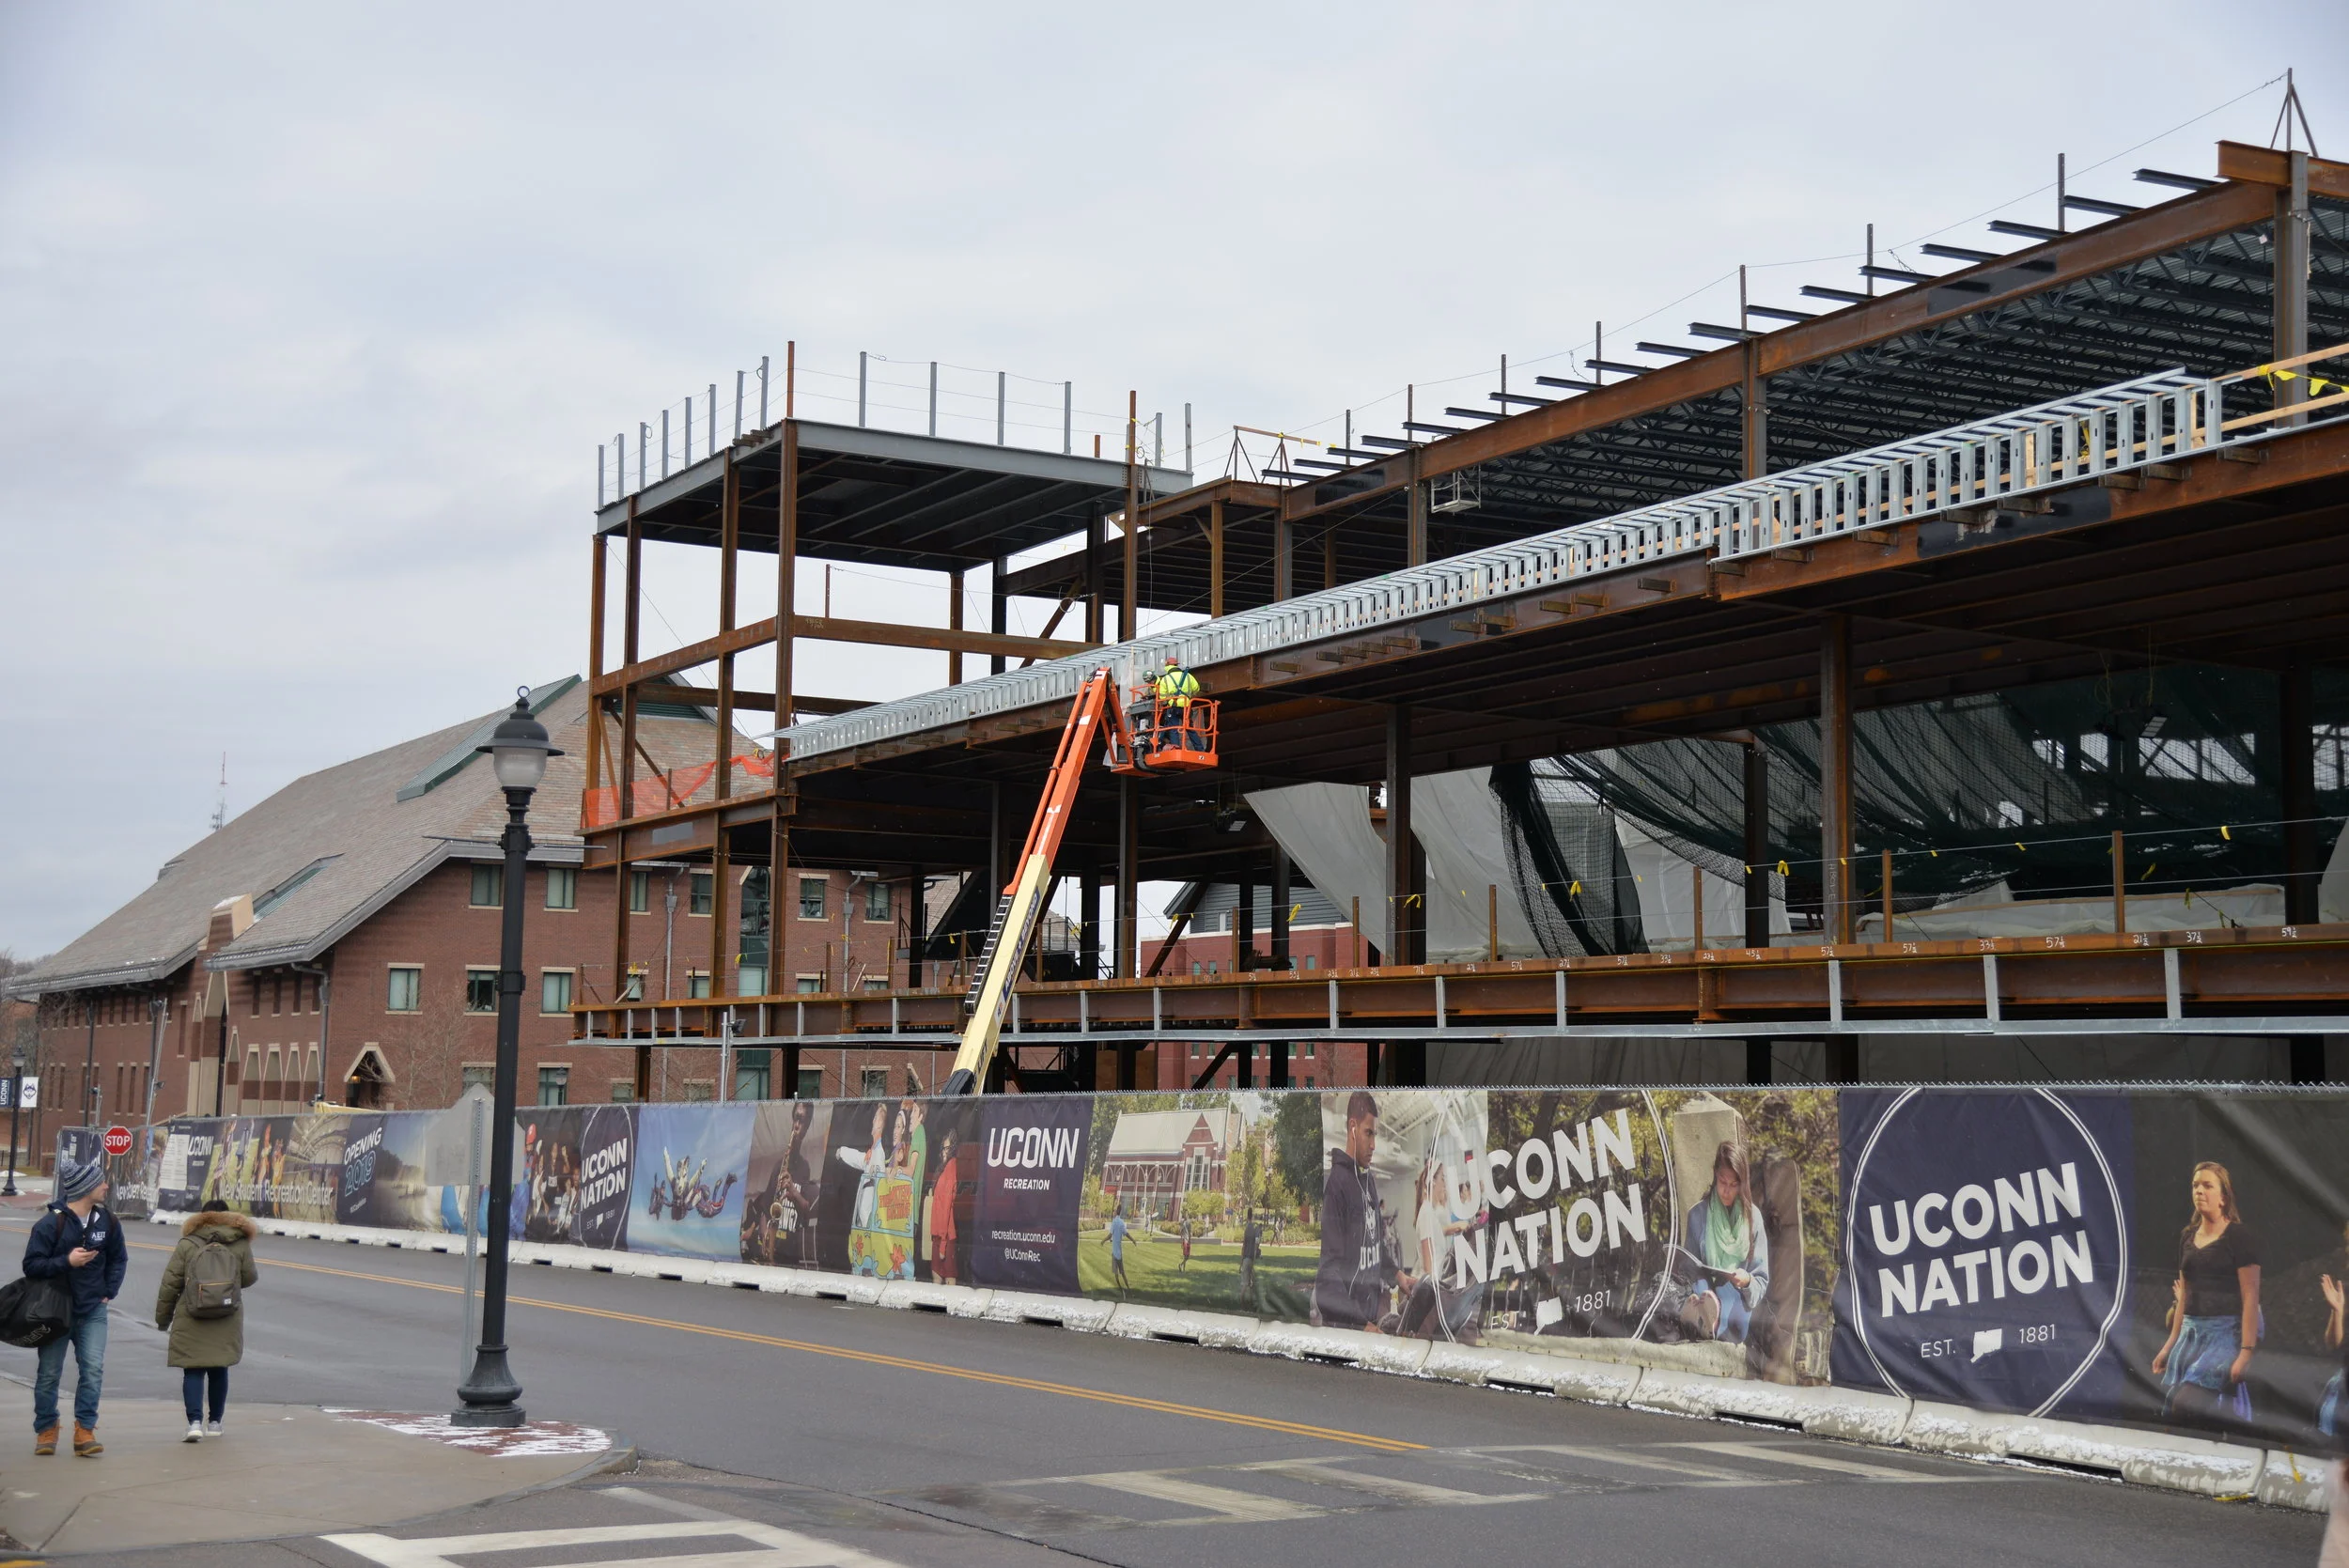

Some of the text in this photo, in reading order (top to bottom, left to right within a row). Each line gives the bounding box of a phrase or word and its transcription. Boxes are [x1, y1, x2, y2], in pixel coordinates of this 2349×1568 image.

[0, 1079, 8, 1106] UCONN
[105, 1135, 131, 1146] STOP
[188, 1136, 214, 1156] UCONN
[344, 1127, 382, 1165] OPENING
[987, 1127, 1080, 1168] UCONN
[345, 1150, 376, 1197] 2019
[582, 1138, 628, 1184] UCONN
[1447, 1109, 1636, 1219] UCONN
[307, 1181, 333, 1204] Center
[581, 1167, 627, 1212] NATION
[1003, 1178, 1050, 1190] RECREATION
[1869, 1162, 2081, 1256] UCONN
[991, 1230, 1056, 1243] recreation.uconn.edu
[1455, 1183, 1646, 1289] NATION
[1004, 1248, 1041, 1262] @UConnRec
[1878, 1230, 2093, 1318] NATION
[1576, 1290, 1611, 1312] 1881
[1921, 1324, 2055, 1358] EST. 1881
